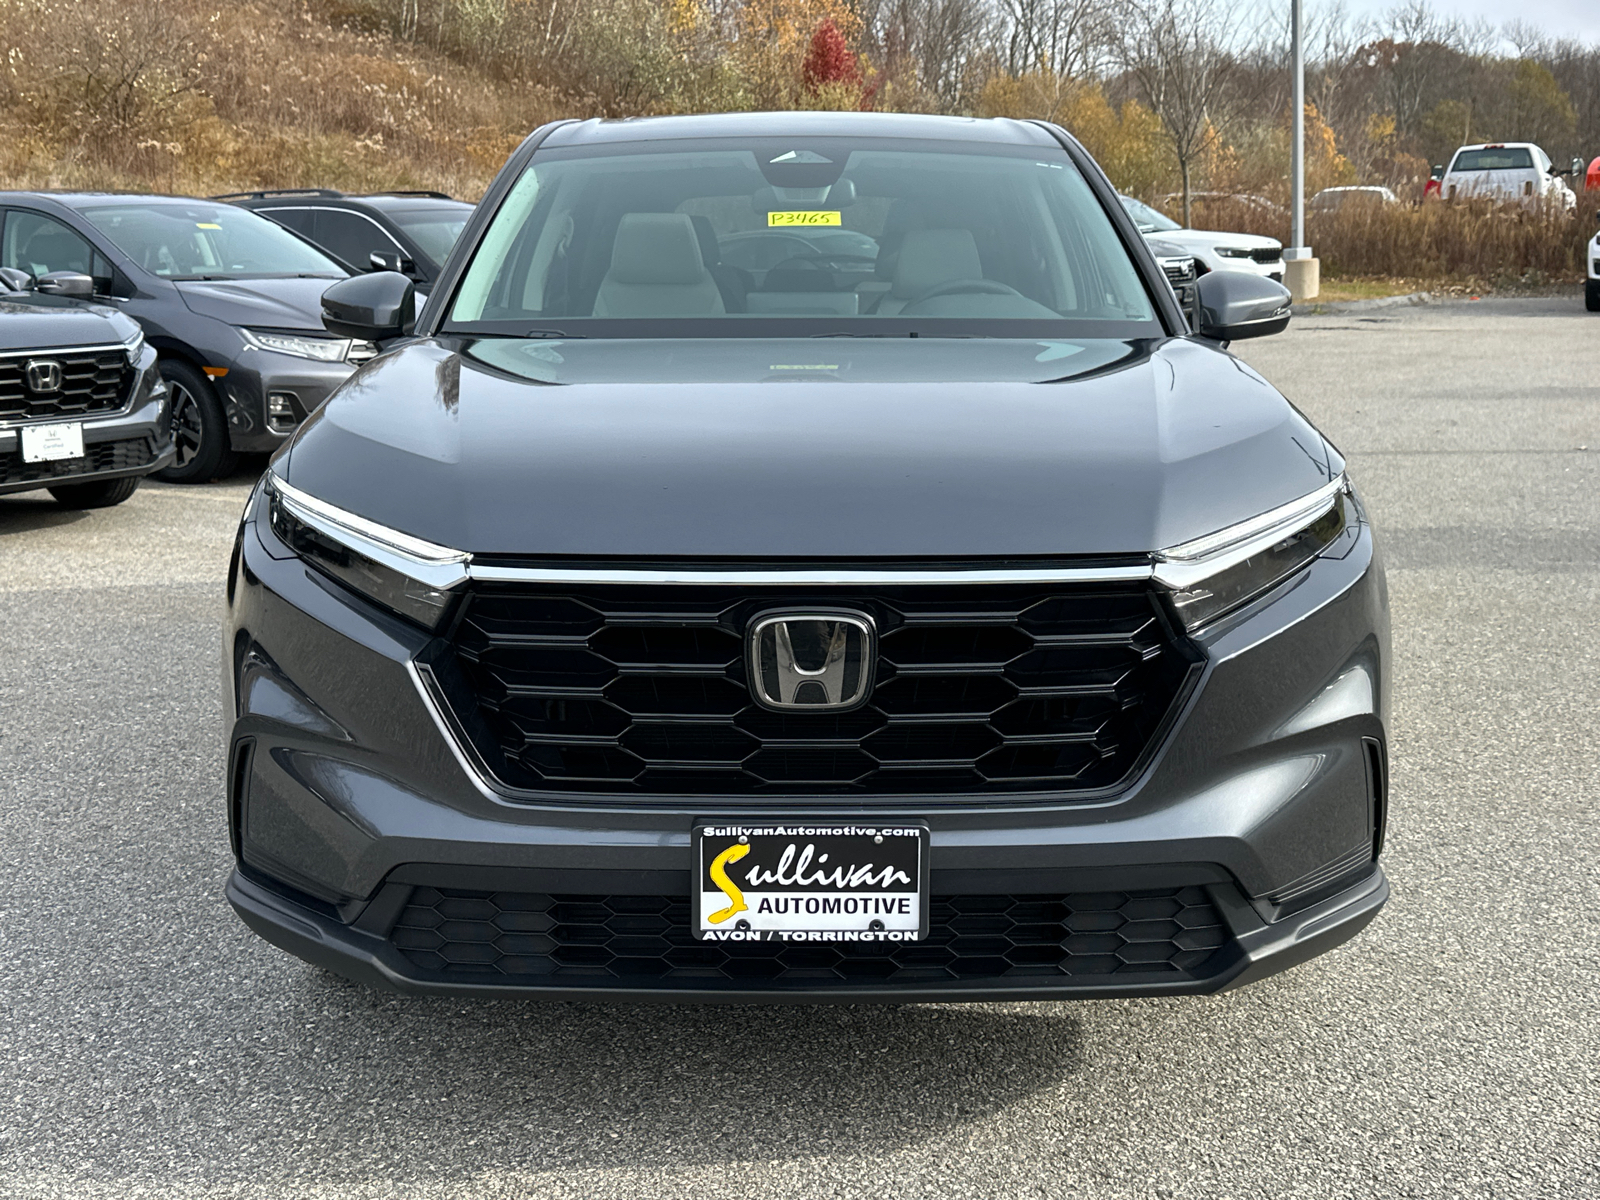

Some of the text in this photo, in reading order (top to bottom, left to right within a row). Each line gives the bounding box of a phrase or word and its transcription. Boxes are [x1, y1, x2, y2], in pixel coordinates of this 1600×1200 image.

[772, 213, 834, 225] P3465
[703, 826, 920, 837] SullivanAutomotive.com
[707, 843, 911, 924] Sullivan
[757, 897, 911, 914] AUTOMOTIVE
[702, 931, 761, 941] AVON
[779, 931, 919, 941] TORRINGTON
